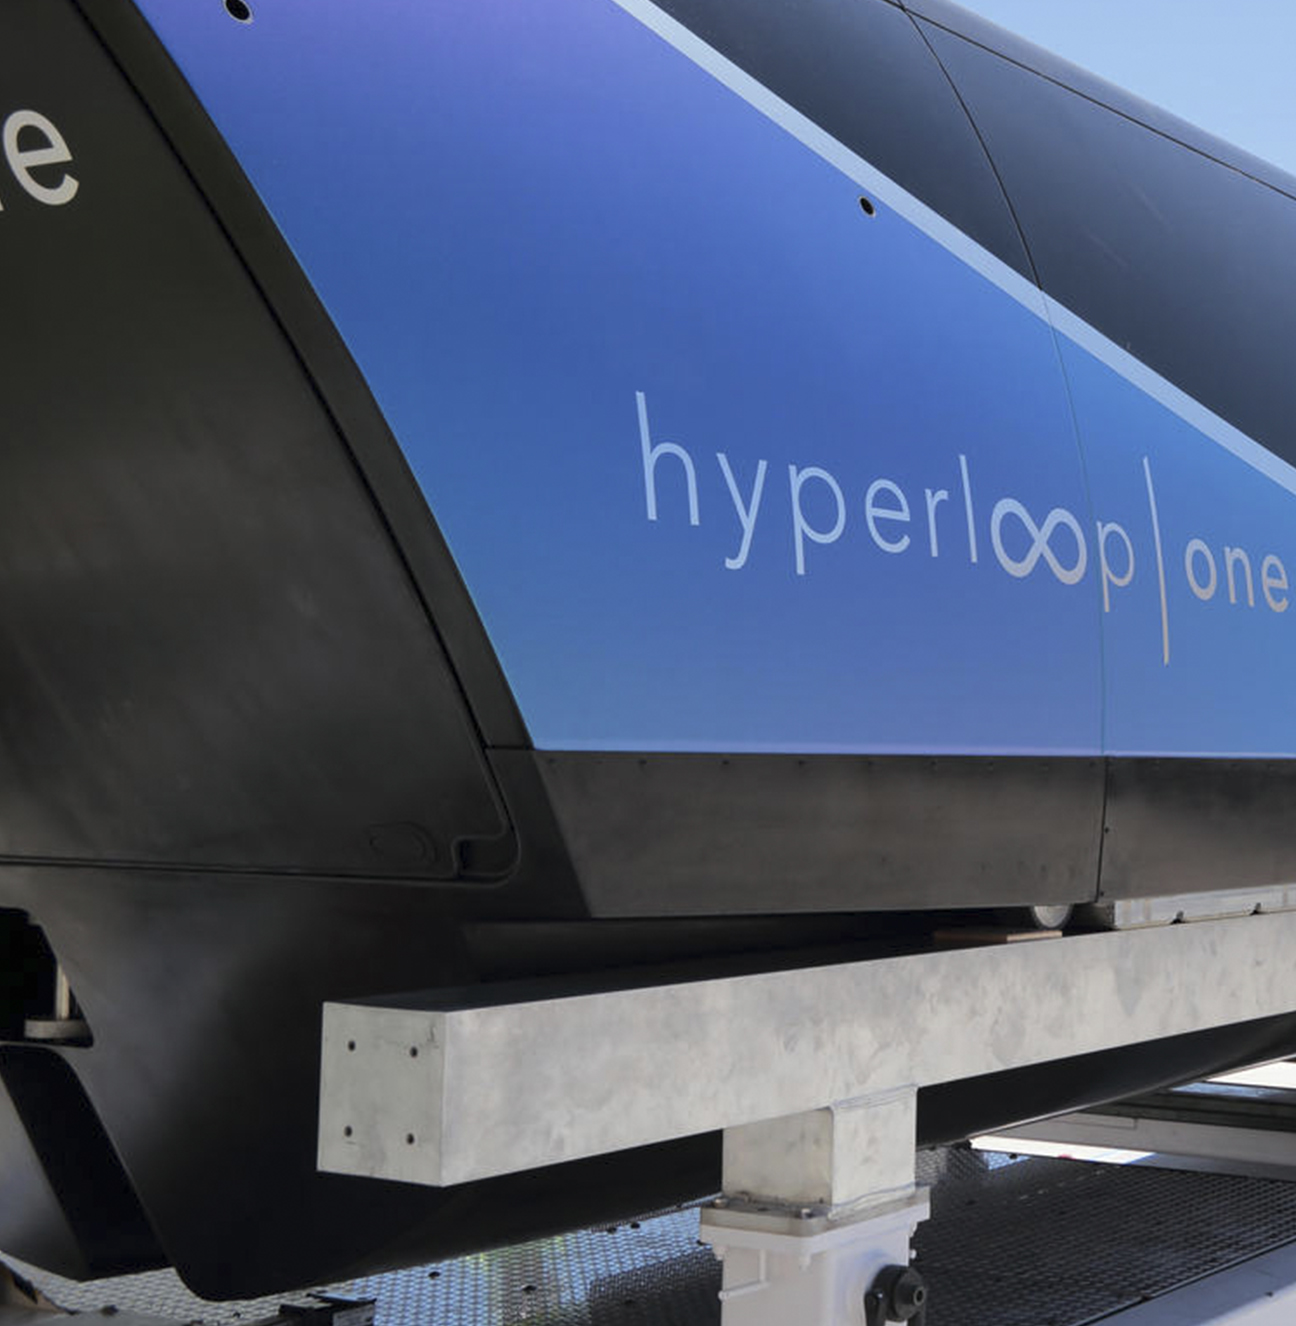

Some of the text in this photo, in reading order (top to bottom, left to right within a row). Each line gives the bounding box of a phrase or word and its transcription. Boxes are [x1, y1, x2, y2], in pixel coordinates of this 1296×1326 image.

[0, 109, 79, 211] e
[636, 390, 1289, 613] hyperloop one
